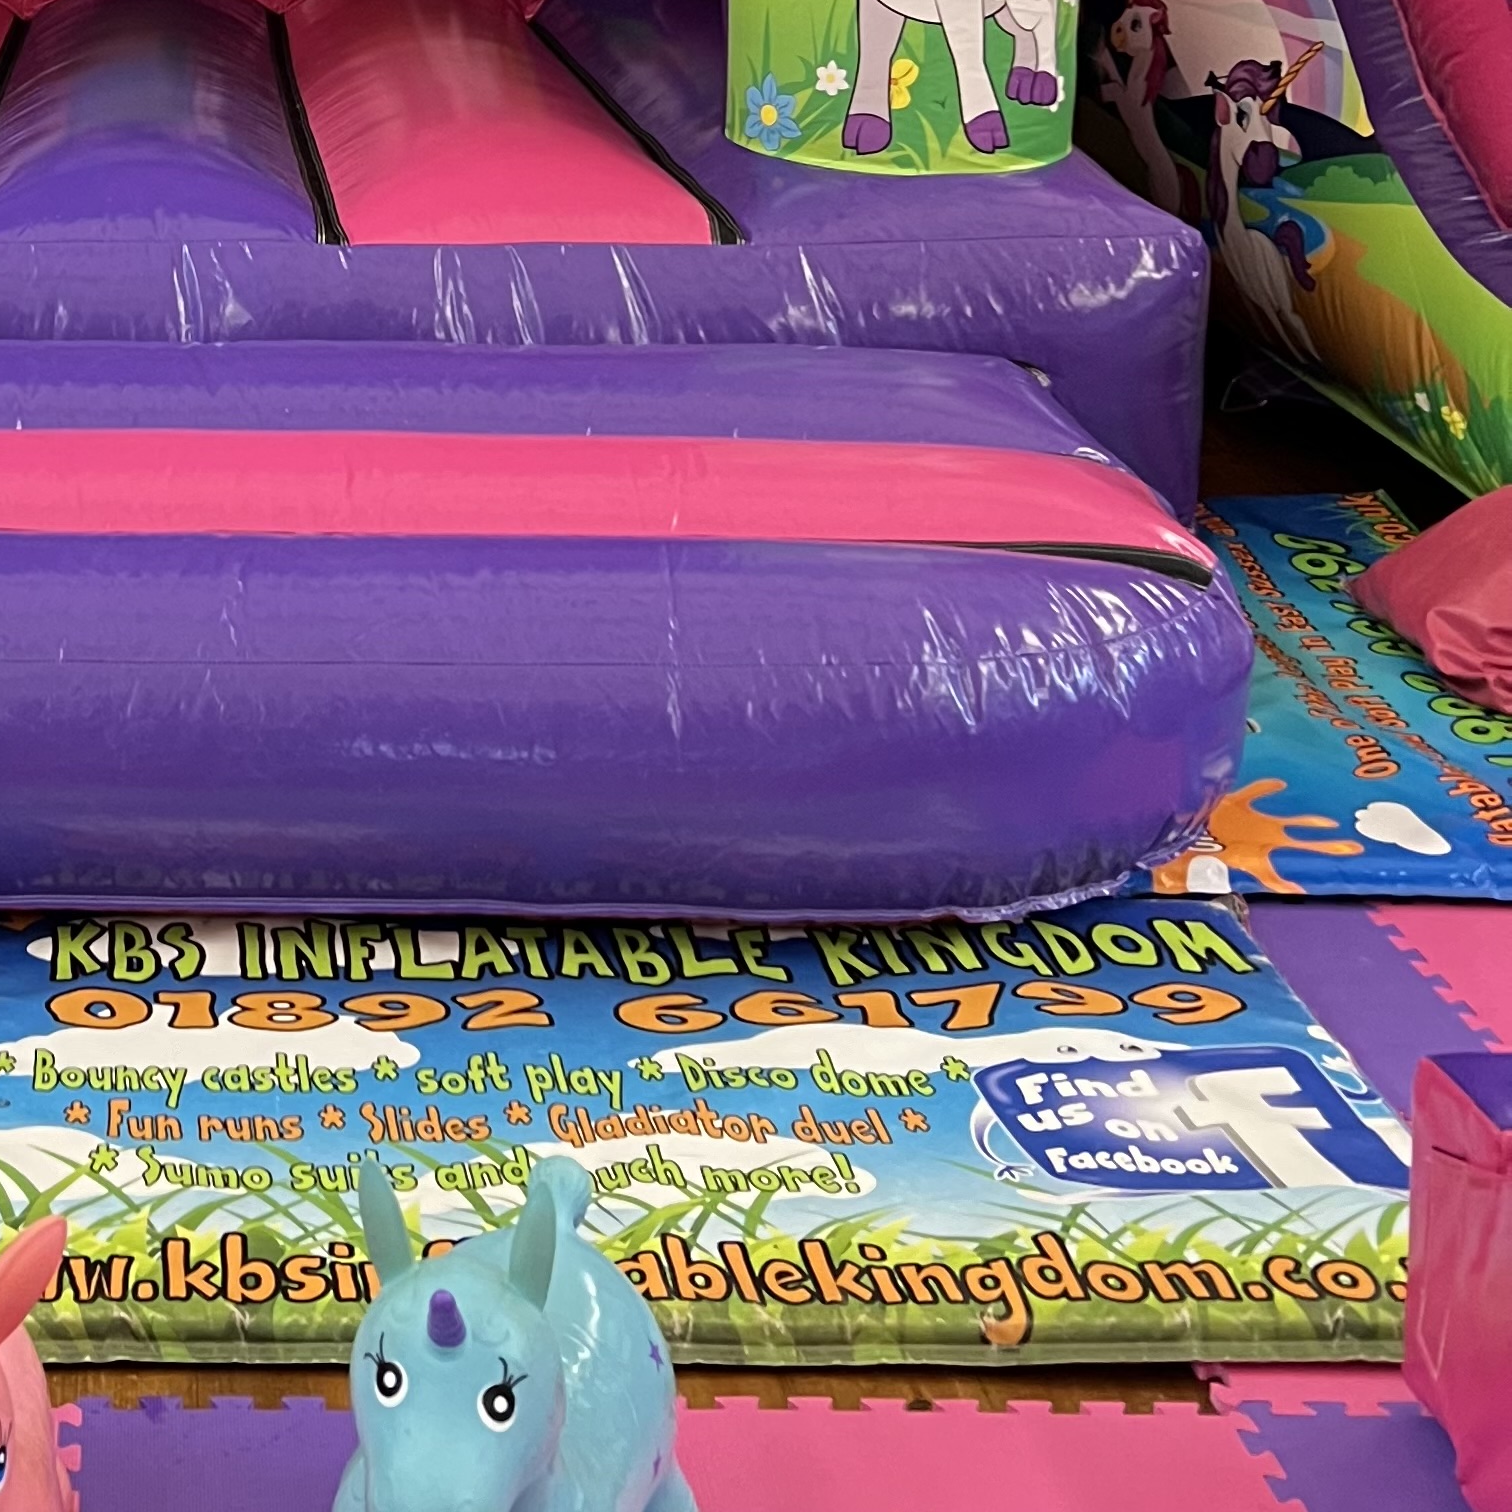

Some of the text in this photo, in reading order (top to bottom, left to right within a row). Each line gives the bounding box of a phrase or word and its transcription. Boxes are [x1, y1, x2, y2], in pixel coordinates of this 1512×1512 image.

[49, 916, 1256, 987] KBS INFLATABLE KINGDOM
[45, 980, 1248, 1033] 01892 661799
[33, 1048, 936, 1111] Bouncy castles soft play Disco dome
[1016, 1069, 1159, 1105] Find
[106, 1098, 893, 1148] Fun runs Slides Gladiator duel
[1017, 1102, 1178, 1141] us on
[135, 1145, 273, 1190] Sumo
[435, 1145, 531, 1192] and
[587, 1144, 688, 1192] uch
[699, 1152, 860, 1194] more!
[1044, 1145, 1239, 1175] Facebook
